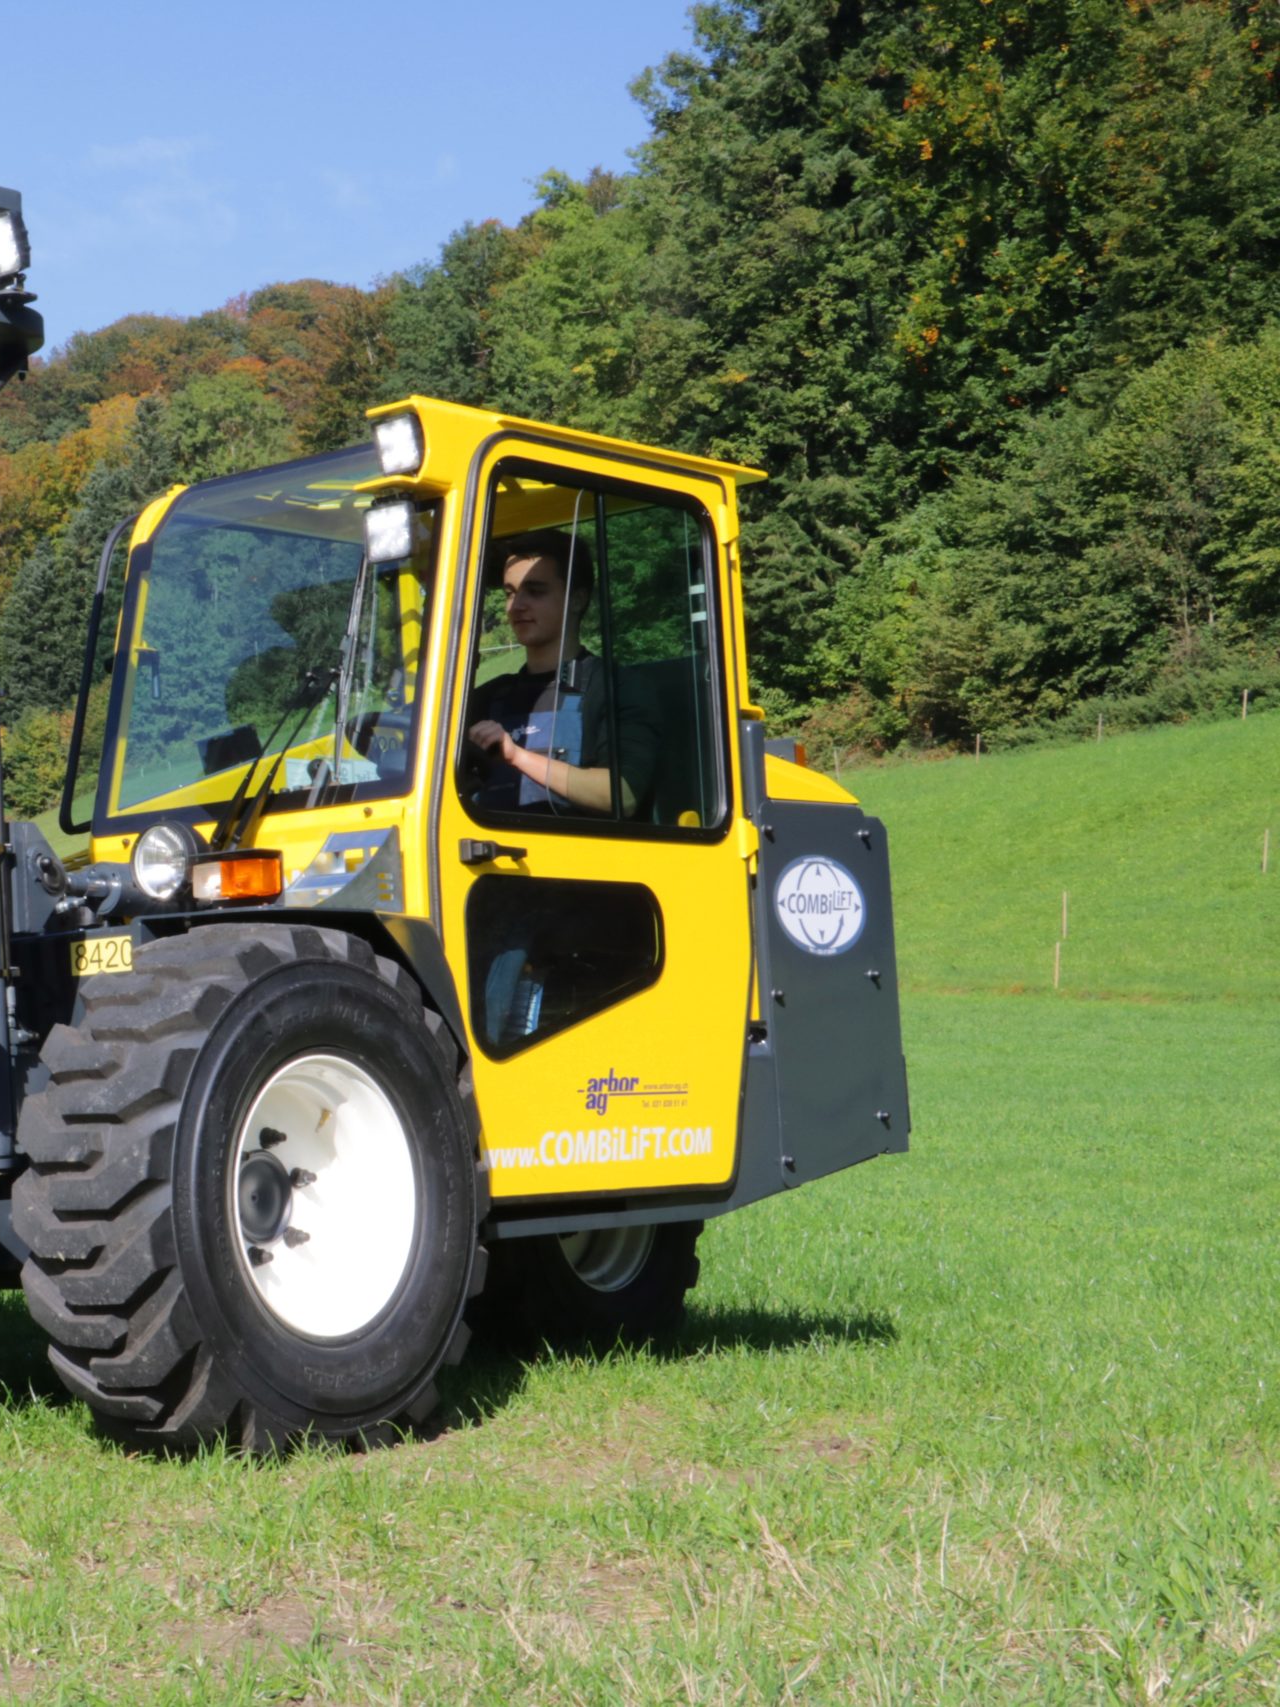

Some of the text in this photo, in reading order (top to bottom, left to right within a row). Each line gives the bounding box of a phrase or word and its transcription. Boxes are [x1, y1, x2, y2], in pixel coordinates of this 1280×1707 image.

[74, 938, 133, 972] 8420
[586, 1067, 640, 1092] arbor
[585, 1093, 609, 1116] ag
